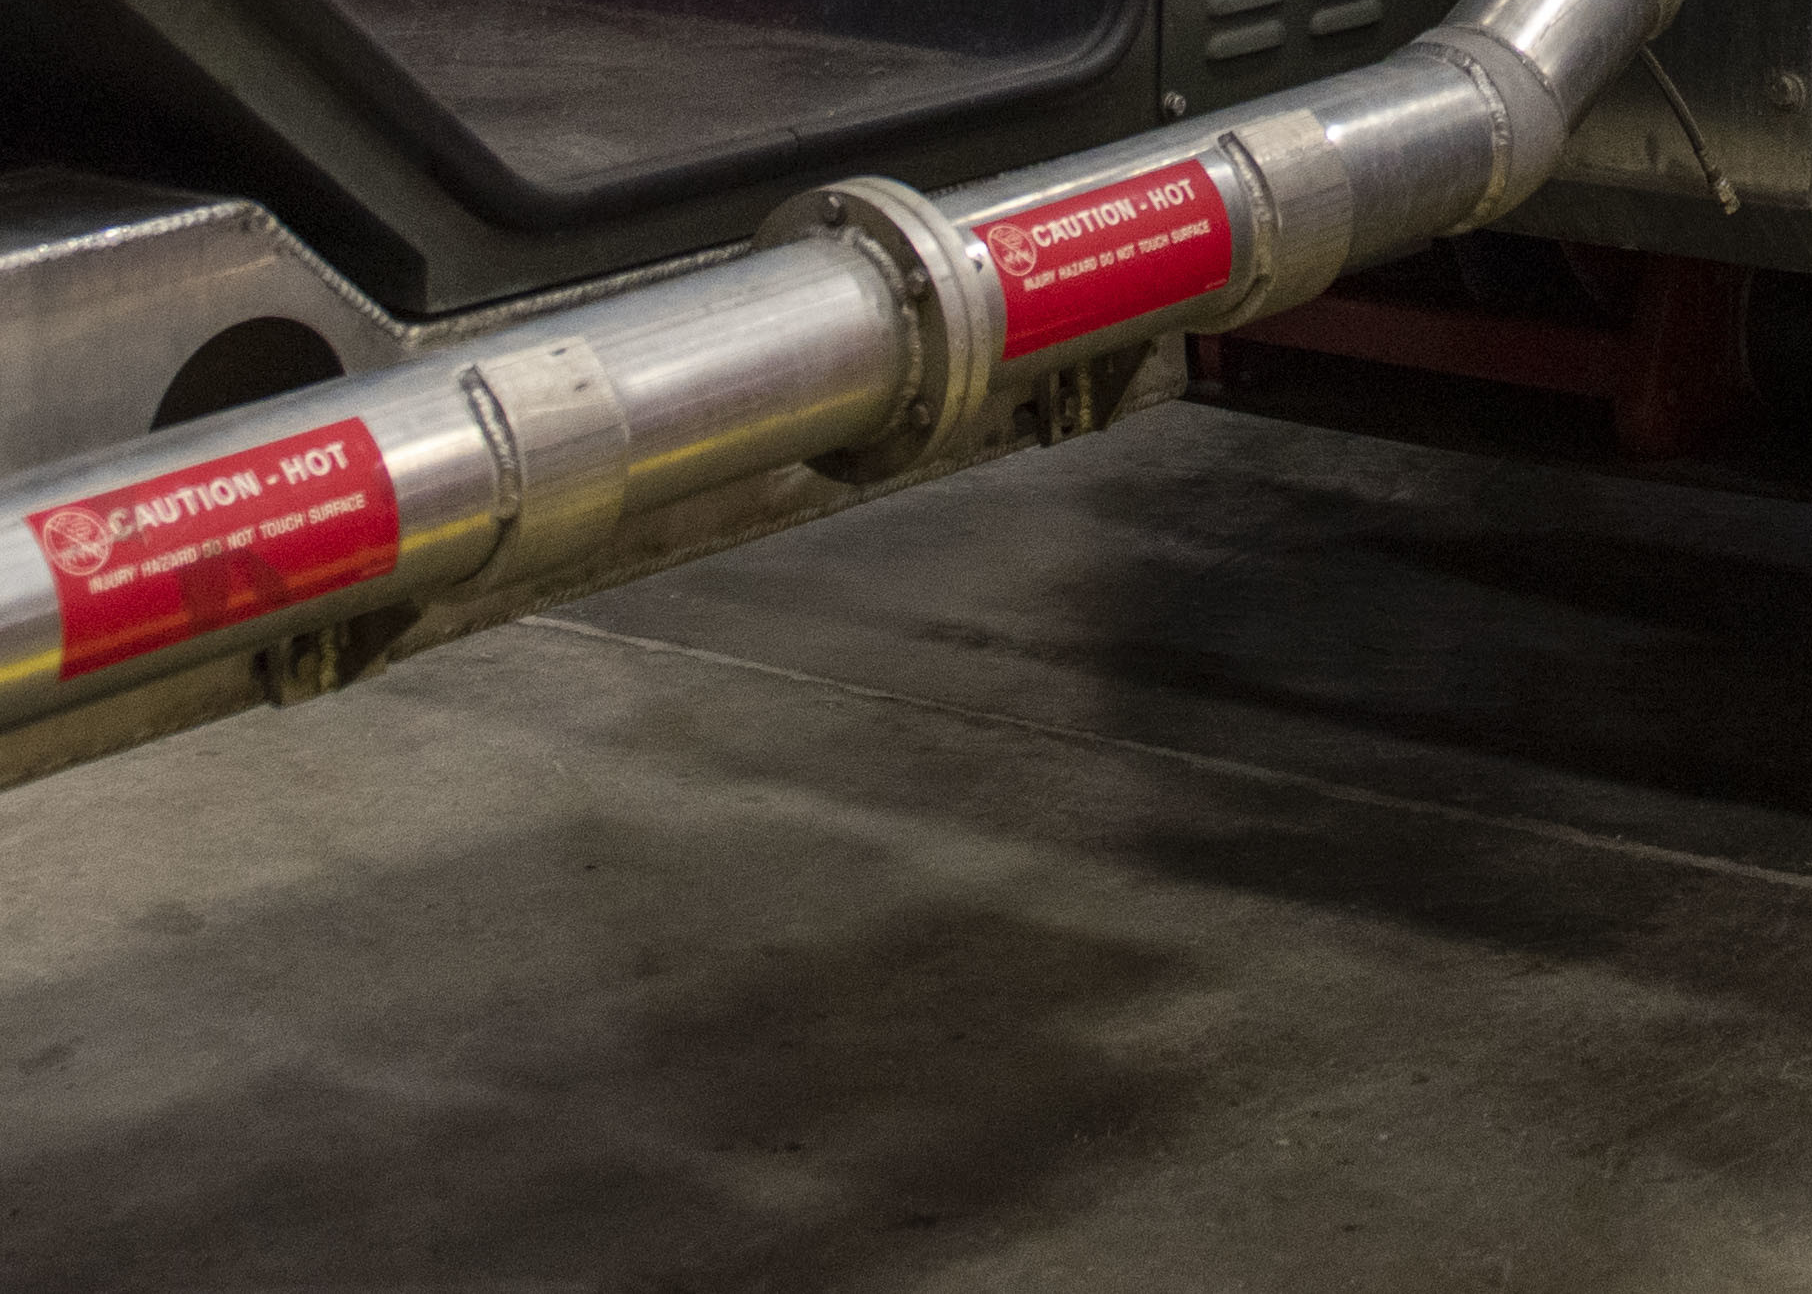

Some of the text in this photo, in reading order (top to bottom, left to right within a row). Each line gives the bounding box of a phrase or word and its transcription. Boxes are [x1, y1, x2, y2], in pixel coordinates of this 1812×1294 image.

[1031, 198, 1137, 248] CAUTION
[1146, 178, 1196, 212] HOT
[106, 469, 263, 541] CAUTION
[279, 440, 350, 487] HOT
[87, 493, 367, 596] INJURY HAZARD DO NOT TOUCH SURFACE
